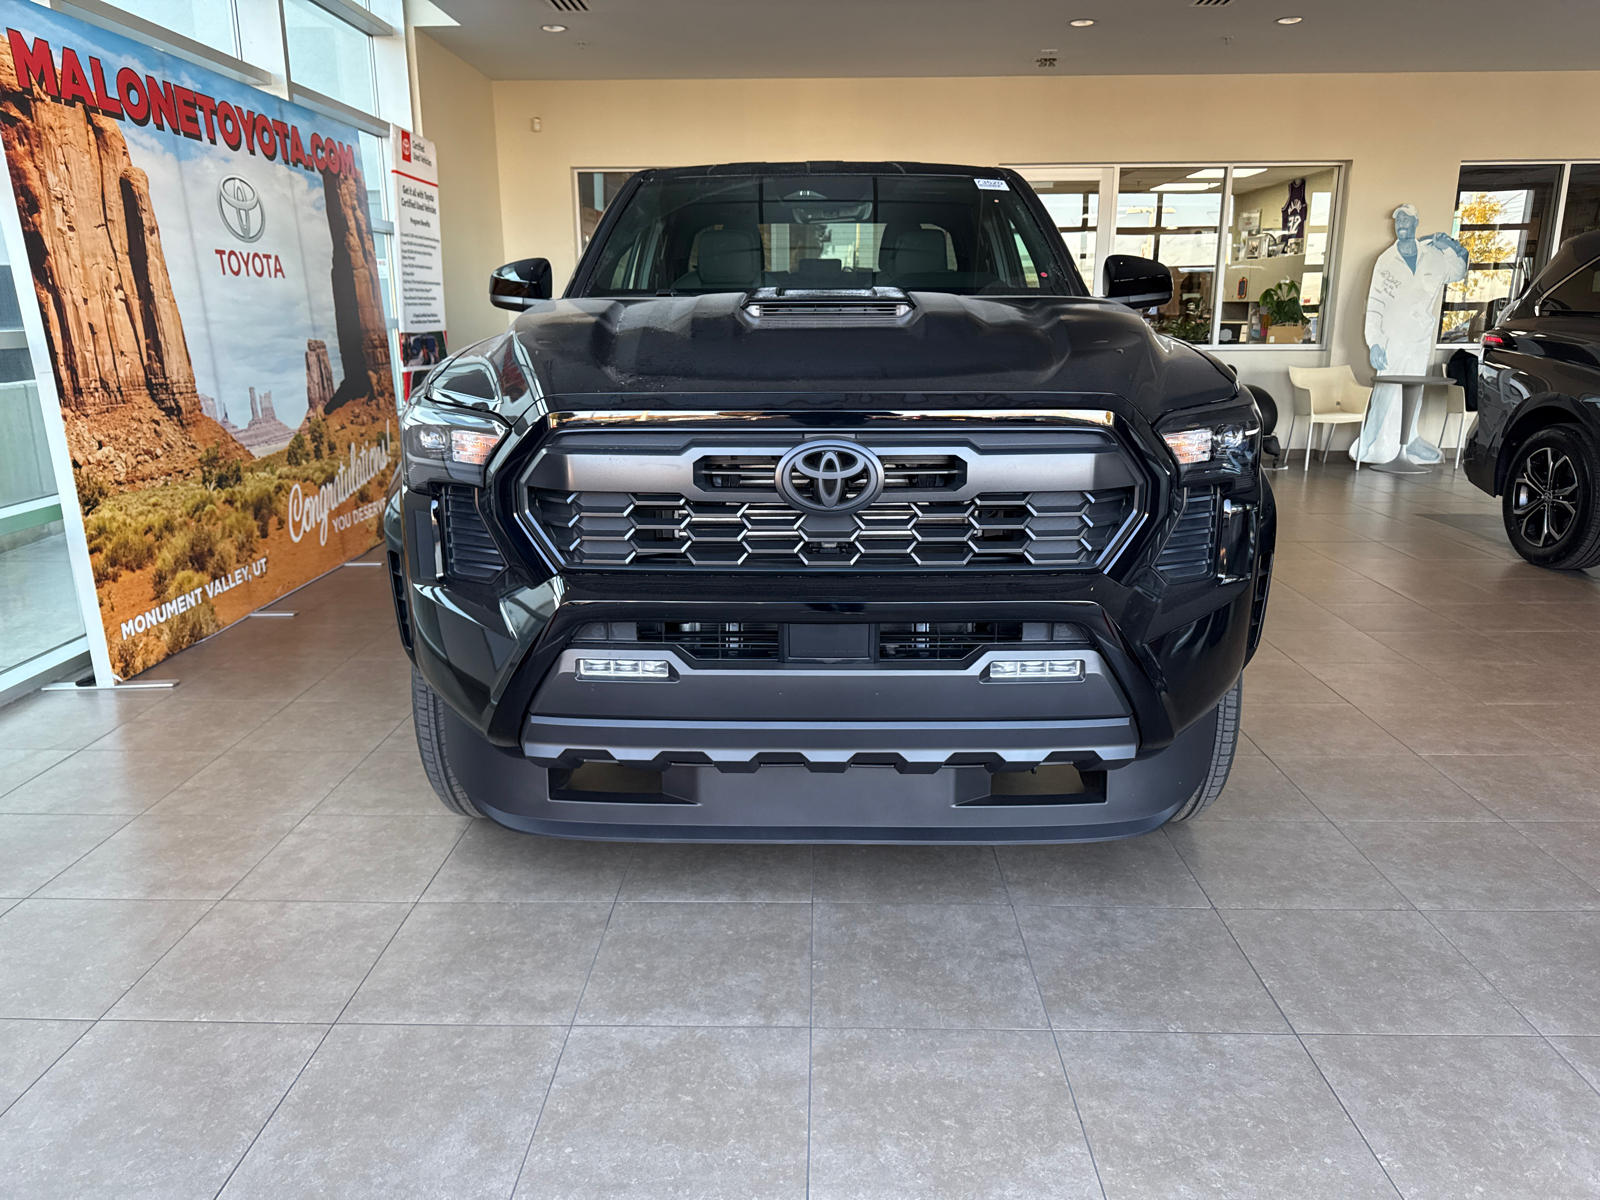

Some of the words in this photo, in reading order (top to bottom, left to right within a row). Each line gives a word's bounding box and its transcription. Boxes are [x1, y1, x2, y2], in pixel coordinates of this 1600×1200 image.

[6, 27, 357, 179] MALONETOYOTA.COM
[214, 248, 286, 279] TOYOTA
[288, 418, 392, 547] Congratulations!
[332, 512, 352, 533] YOU
[120, 586, 203, 641] MONUMENT
[204, 565, 252, 599] VALLEY,
[252, 557, 268, 577] UT
